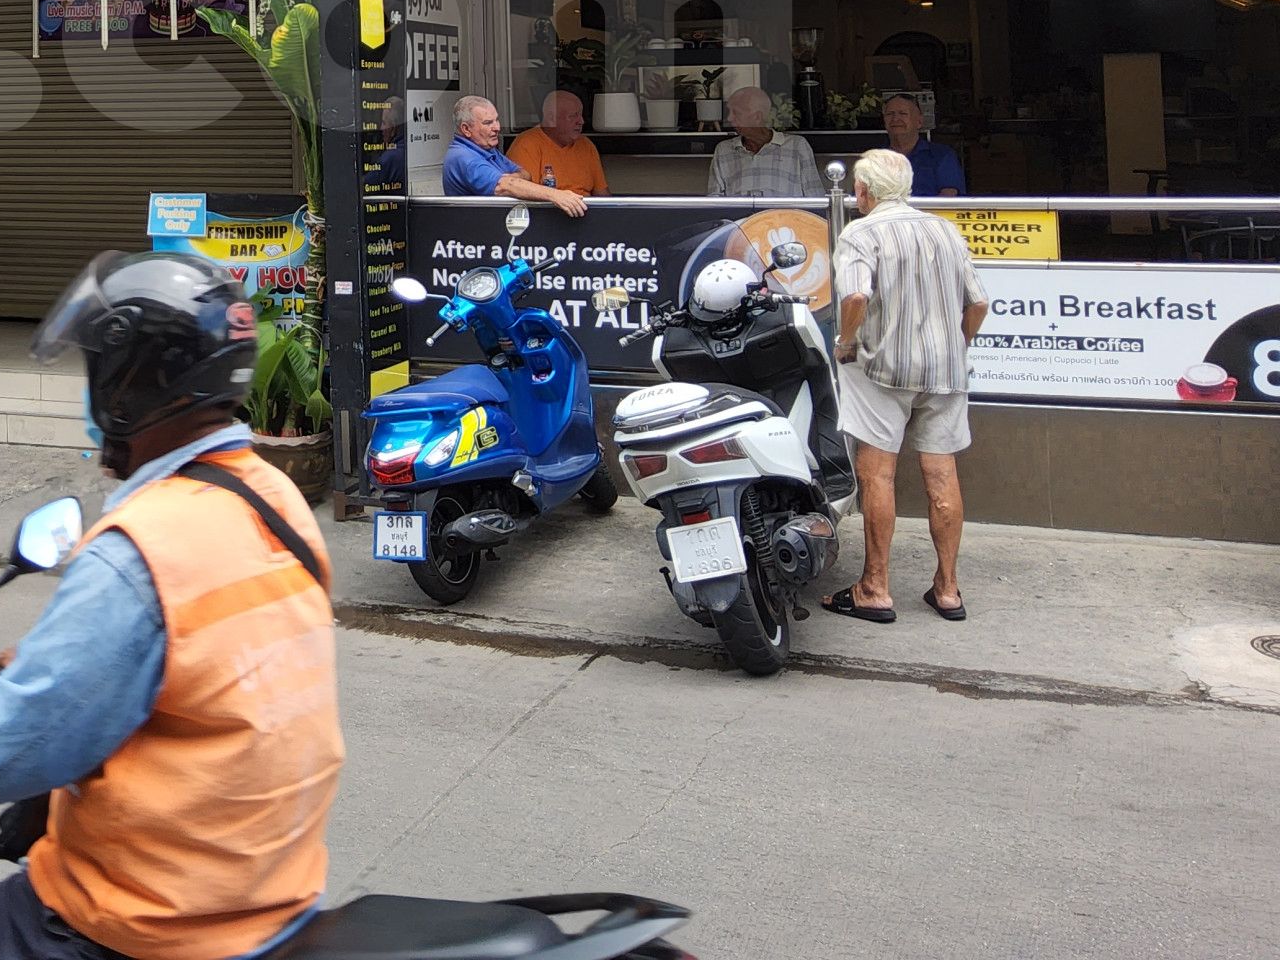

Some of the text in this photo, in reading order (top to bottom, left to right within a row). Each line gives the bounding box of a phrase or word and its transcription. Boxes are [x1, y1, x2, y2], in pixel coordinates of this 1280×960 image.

[65, 3, 94, 17] music
[64, 19, 128, 32] FREE FOD
[407, 31, 459, 80] FFEE
[956, 211, 997, 220] at all
[207, 226, 288, 239] FRIENDSHIP
[961, 223, 1042, 233] TOMER
[965, 235, 1030, 245] RKING
[230, 244, 257, 257] BAR
[432, 240, 485, 260] After
[491, 246, 503, 260] a
[581, 241, 658, 266] coffee,
[970, 247, 1011, 256] NLY
[536, 271, 659, 294] lse matters
[548, 300, 588, 327] AT
[991, 294, 1217, 321] can Breakfast
[1011, 336, 1079, 351] Arabica
[1085, 338, 1142, 353] Coffee
[969, 355, 999, 364] spresso
[1005, 355, 1047, 363] Americano
[382, 544, 418, 557] 8148
